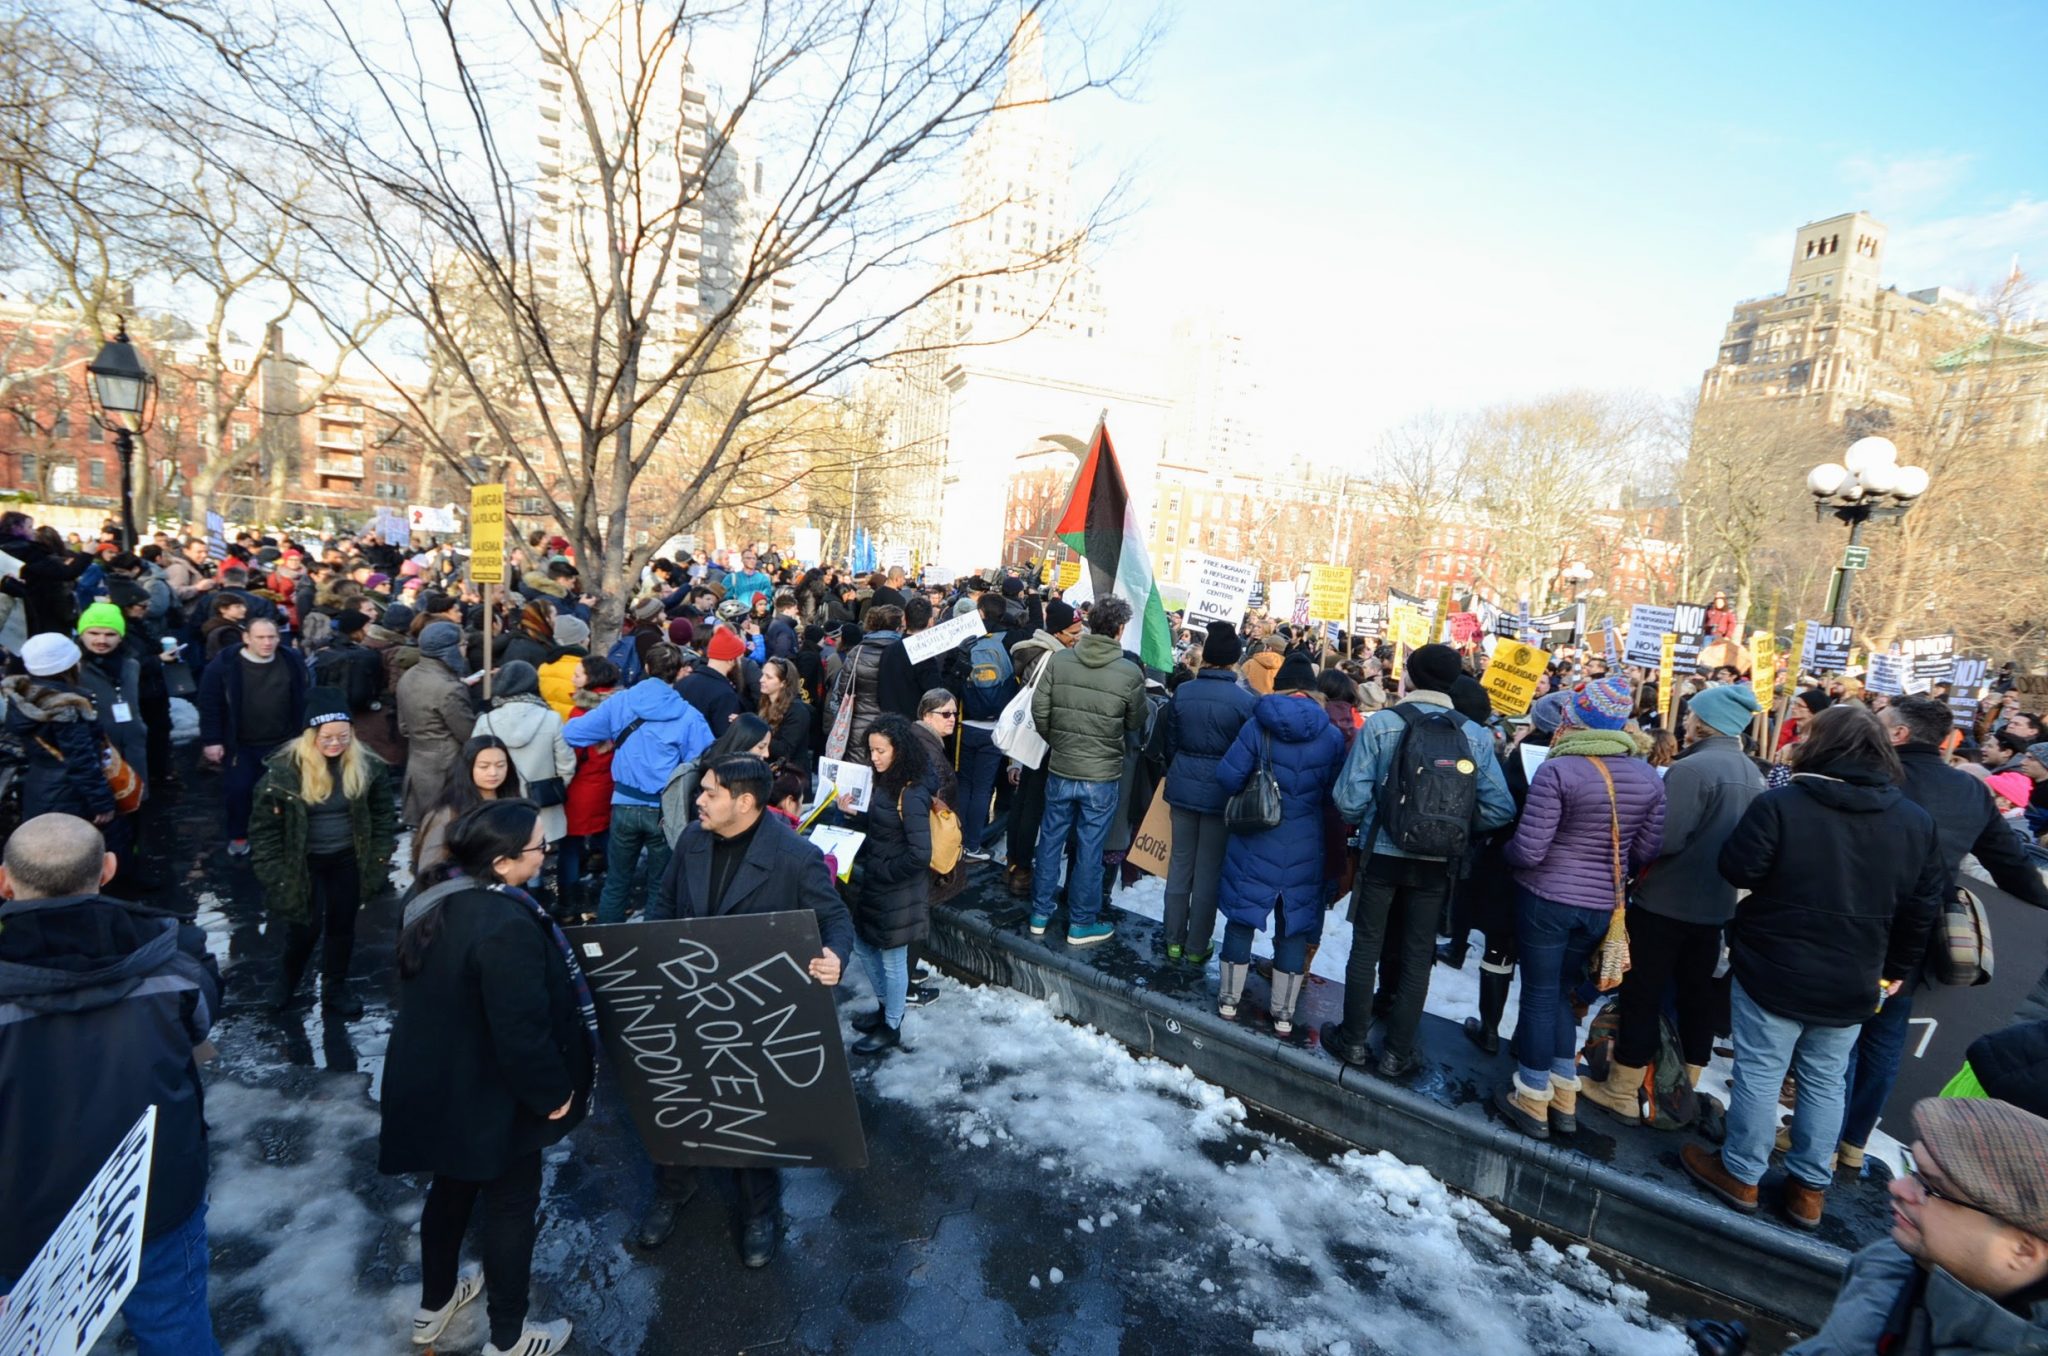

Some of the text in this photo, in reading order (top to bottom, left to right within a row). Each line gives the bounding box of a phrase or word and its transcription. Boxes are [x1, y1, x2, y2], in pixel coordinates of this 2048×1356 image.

[1203, 559, 1251, 576] FREE MIGRANTS
[1209, 570, 1240, 583] REFUGEES
[1206, 588, 1234, 600] CENTERS
[1211, 580, 1245, 593] DETENTION
[1200, 600, 1233, 617] NOW
[1673, 604, 1705, 635] NO!
[1817, 626, 1852, 646] NO!
[1915, 636, 1953, 656] NO!
[1635, 641, 1661, 653] NOW
[1491, 660, 1538, 682] SOLIDARIDAD
[1954, 659, 1987, 688] NO!
[1507, 683, 1523, 696] LOS
[1134, 832, 1168, 862] don't
[726, 950, 826, 1088] END
[656, 937, 777, 1147] BROKEN
